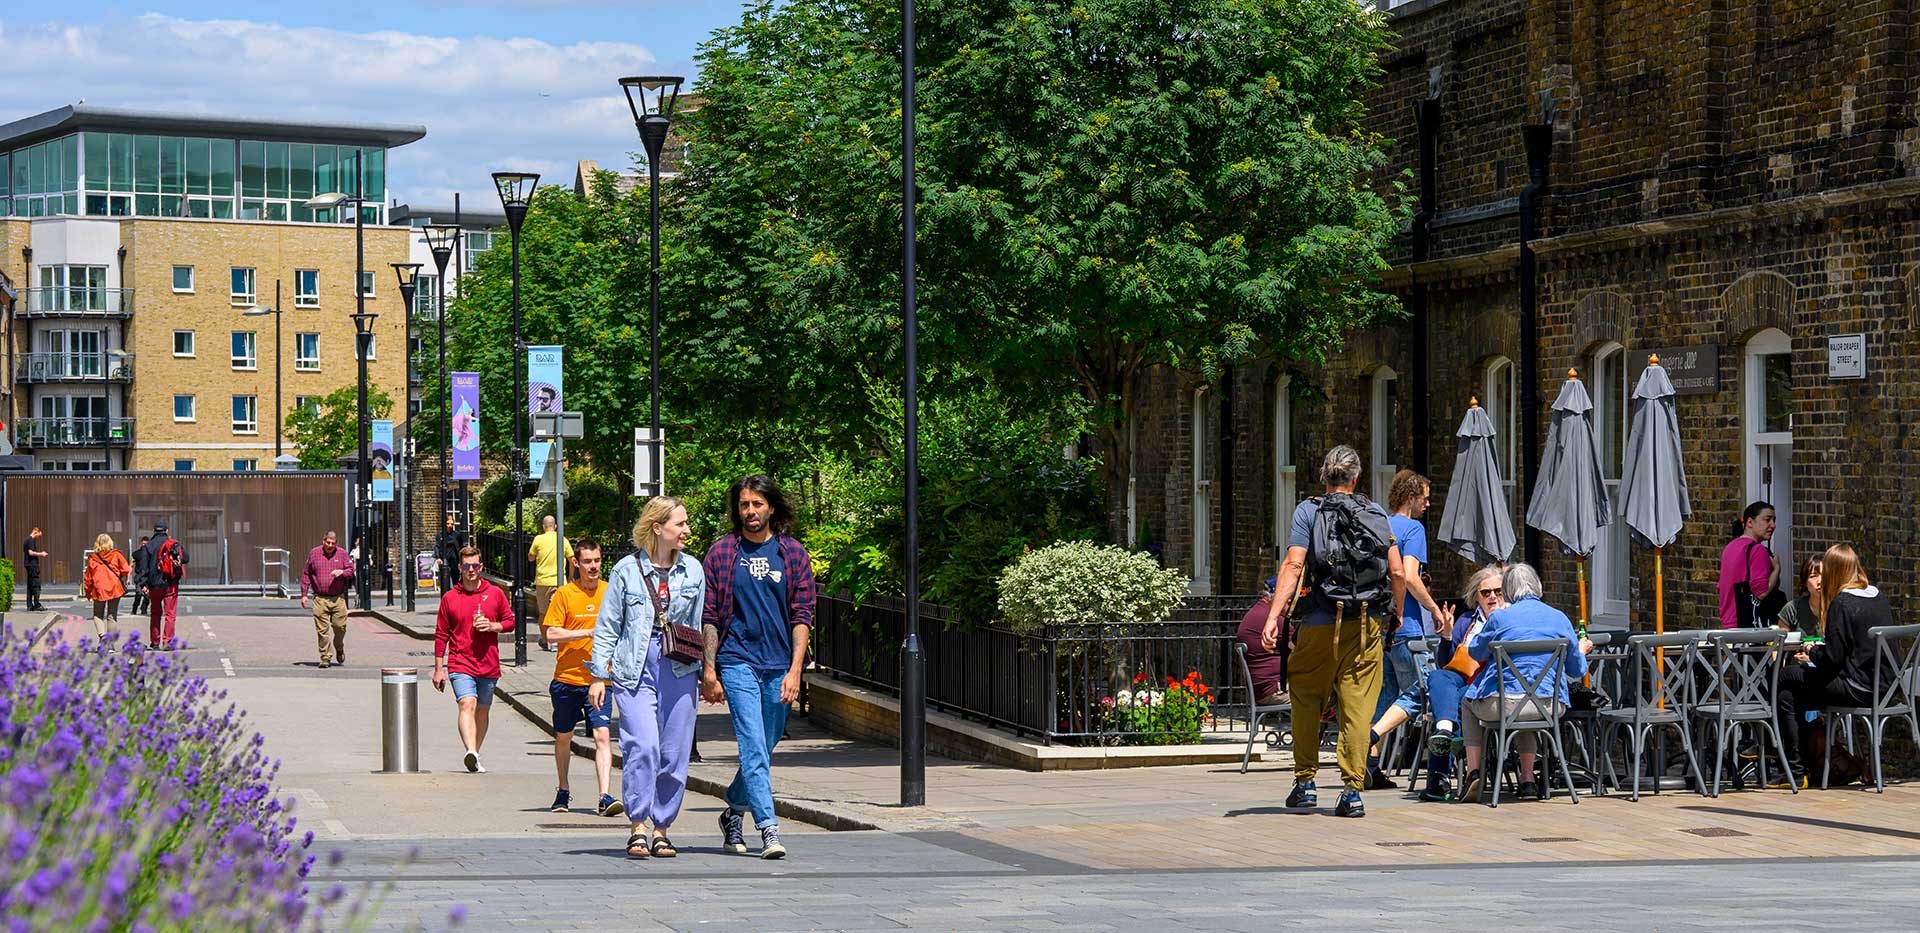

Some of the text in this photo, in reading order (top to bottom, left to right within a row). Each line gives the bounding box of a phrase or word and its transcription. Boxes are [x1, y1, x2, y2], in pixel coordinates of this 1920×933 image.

[1830, 342, 1859, 351] MAJOR DRAPER
[1837, 355, 1852, 364] STREET
